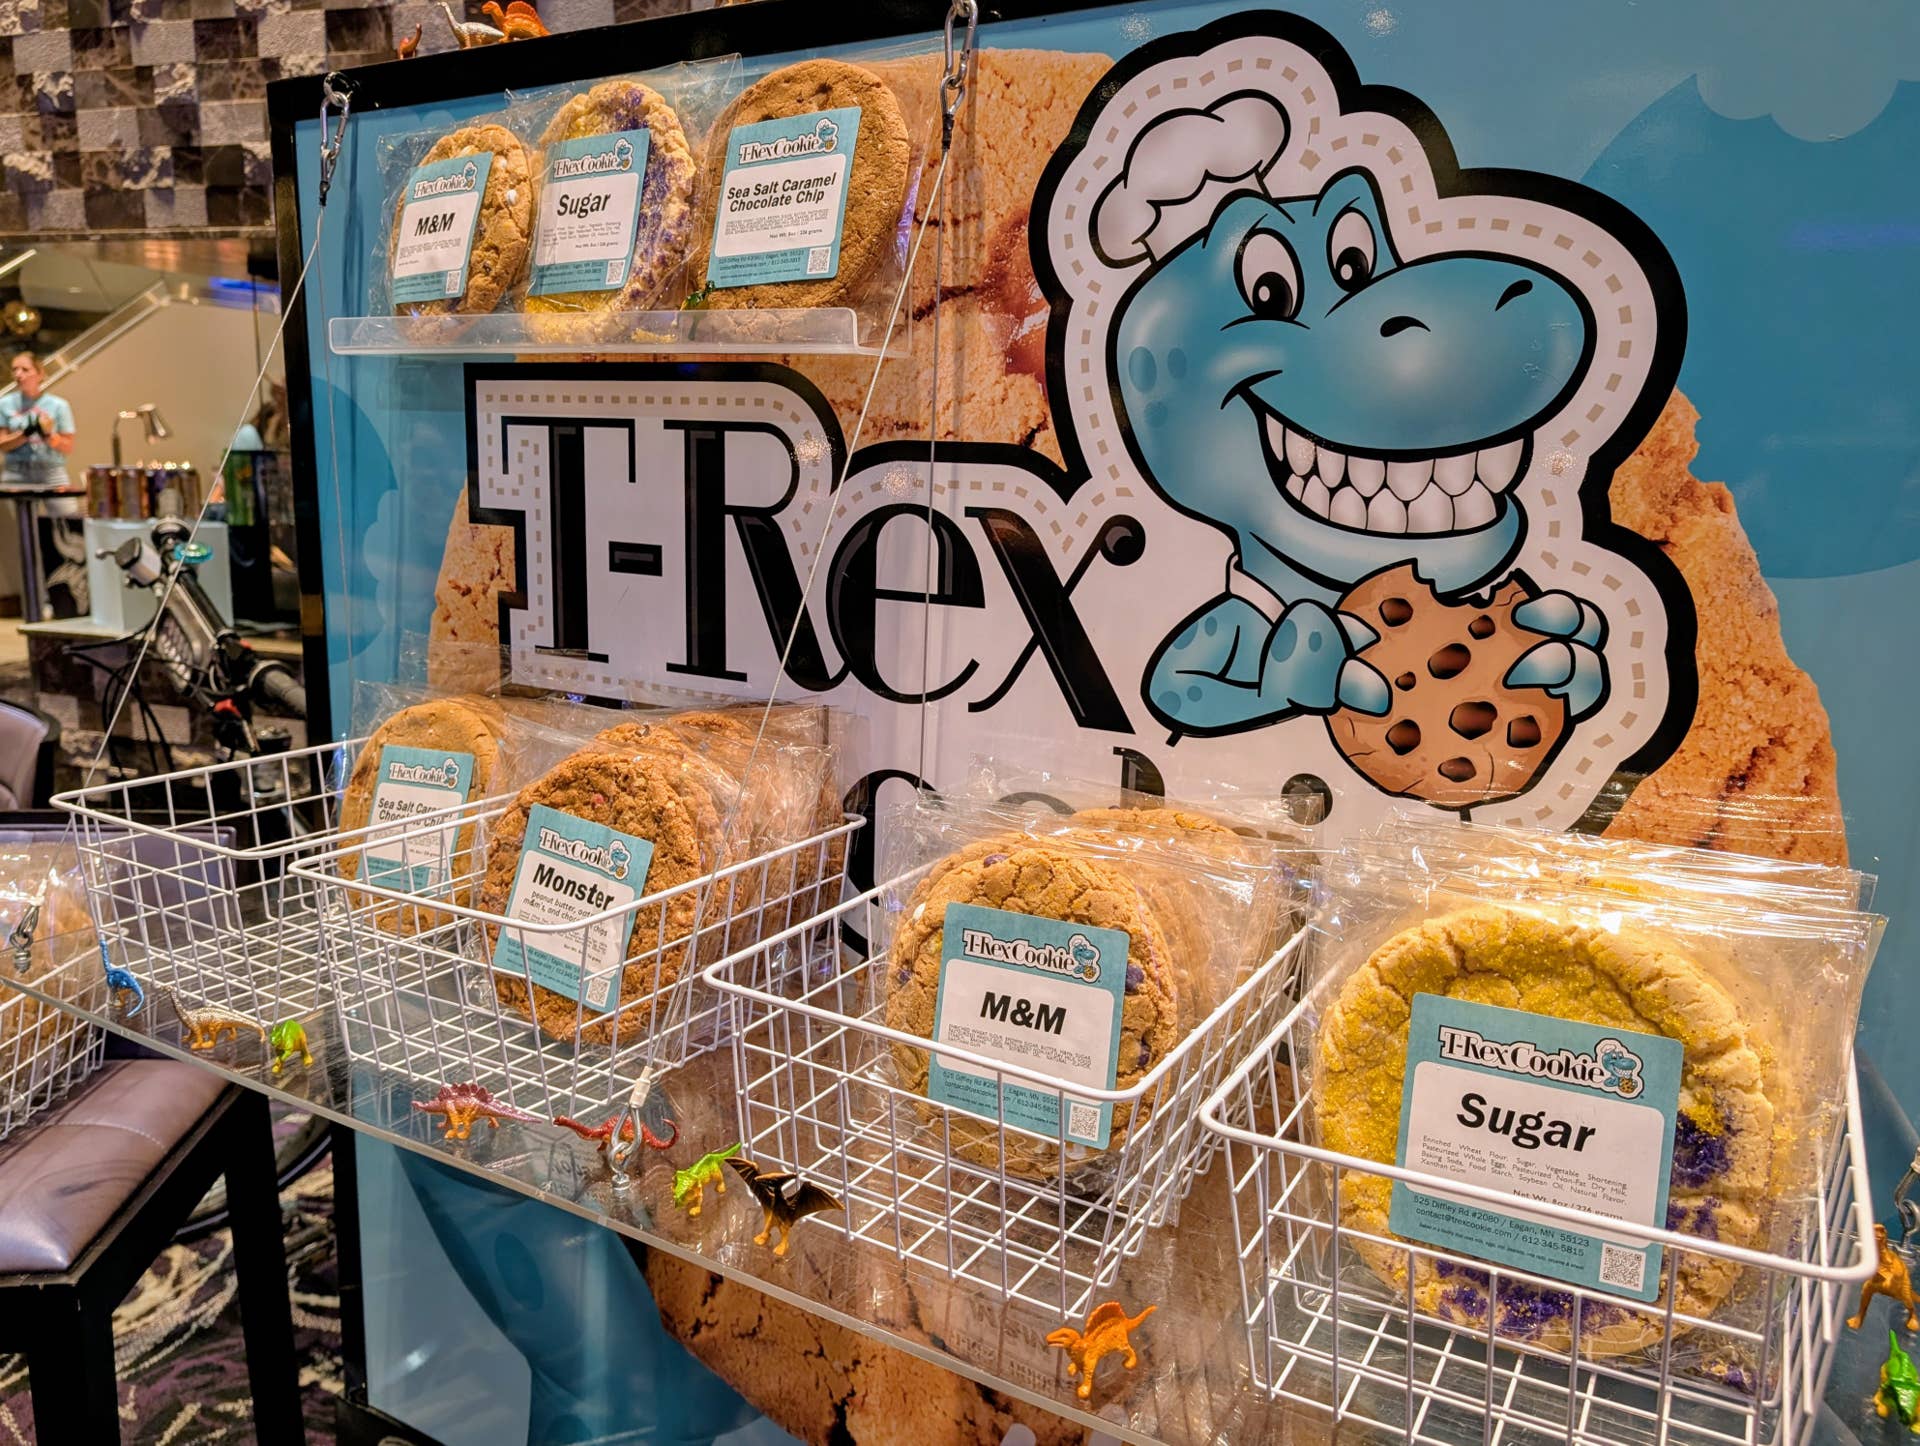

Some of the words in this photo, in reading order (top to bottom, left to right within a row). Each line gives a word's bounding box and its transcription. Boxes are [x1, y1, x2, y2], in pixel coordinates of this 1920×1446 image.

[727, 187, 750, 200] Sea
[753, 181, 778, 196] Salt
[782, 172, 837, 192] Caramel
[730, 195, 792, 212] Chocolate
[796, 190, 824, 204] Chip
[557, 192, 610, 218] Sugar
[414, 212, 456, 236] M&M
[502, 416, 1146, 734] T-Rex
[378, 798, 395, 809] Sea
[396, 800, 414, 812] Salt
[532, 864, 615, 910] Monster
[532, 891, 553, 902] peanut
[555, 898, 576, 914] butter,
[548, 906, 560, 916] and
[1012, 942, 1074, 971] Cookie
[980, 991, 1067, 1035] M&M
[1511, 1046, 1605, 1084] Cookie
[1457, 1092, 1596, 1152] Sugar
[1421, 1158, 1448, 1169] Xanthan
[1450, 1165, 1466, 1173] Gum
[1423, 1143, 1459, 1157] Pasteurized
[1464, 1153, 1486, 1163] Whole
[1512, 1164, 1551, 1179] Pasteurized
[1556, 1175, 1586, 1187] Non-Fat
[1591, 1182, 1606, 1192] Dry
[1424, 1135, 1451, 1148] Enriched
[1459, 1144, 1481, 1154] Wheat
[1546, 1164, 1580, 1177] Vegetable
[1422, 1151, 1442, 1162] Baking
[1469, 1162, 1486, 1171] Food
[1519, 1174, 1548, 1186] Soybean
[1571, 1186, 1597, 1197] Natural
[1513, 1189, 1529, 1198] Net
[1414, 1195, 1430, 1206] 525
[1458, 1208, 1469, 1216] Rd
[1472, 1211, 1499, 1224] #2080
[1509, 1220, 1537, 1234] Eagan,
[1540, 1228, 1555, 1238] MN
[1560, 1233, 1589, 1247] 55123
[1416, 1208, 1512, 1238] contact@trexcookie.com
[1522, 1235, 1584, 1257] 612-345-5815
